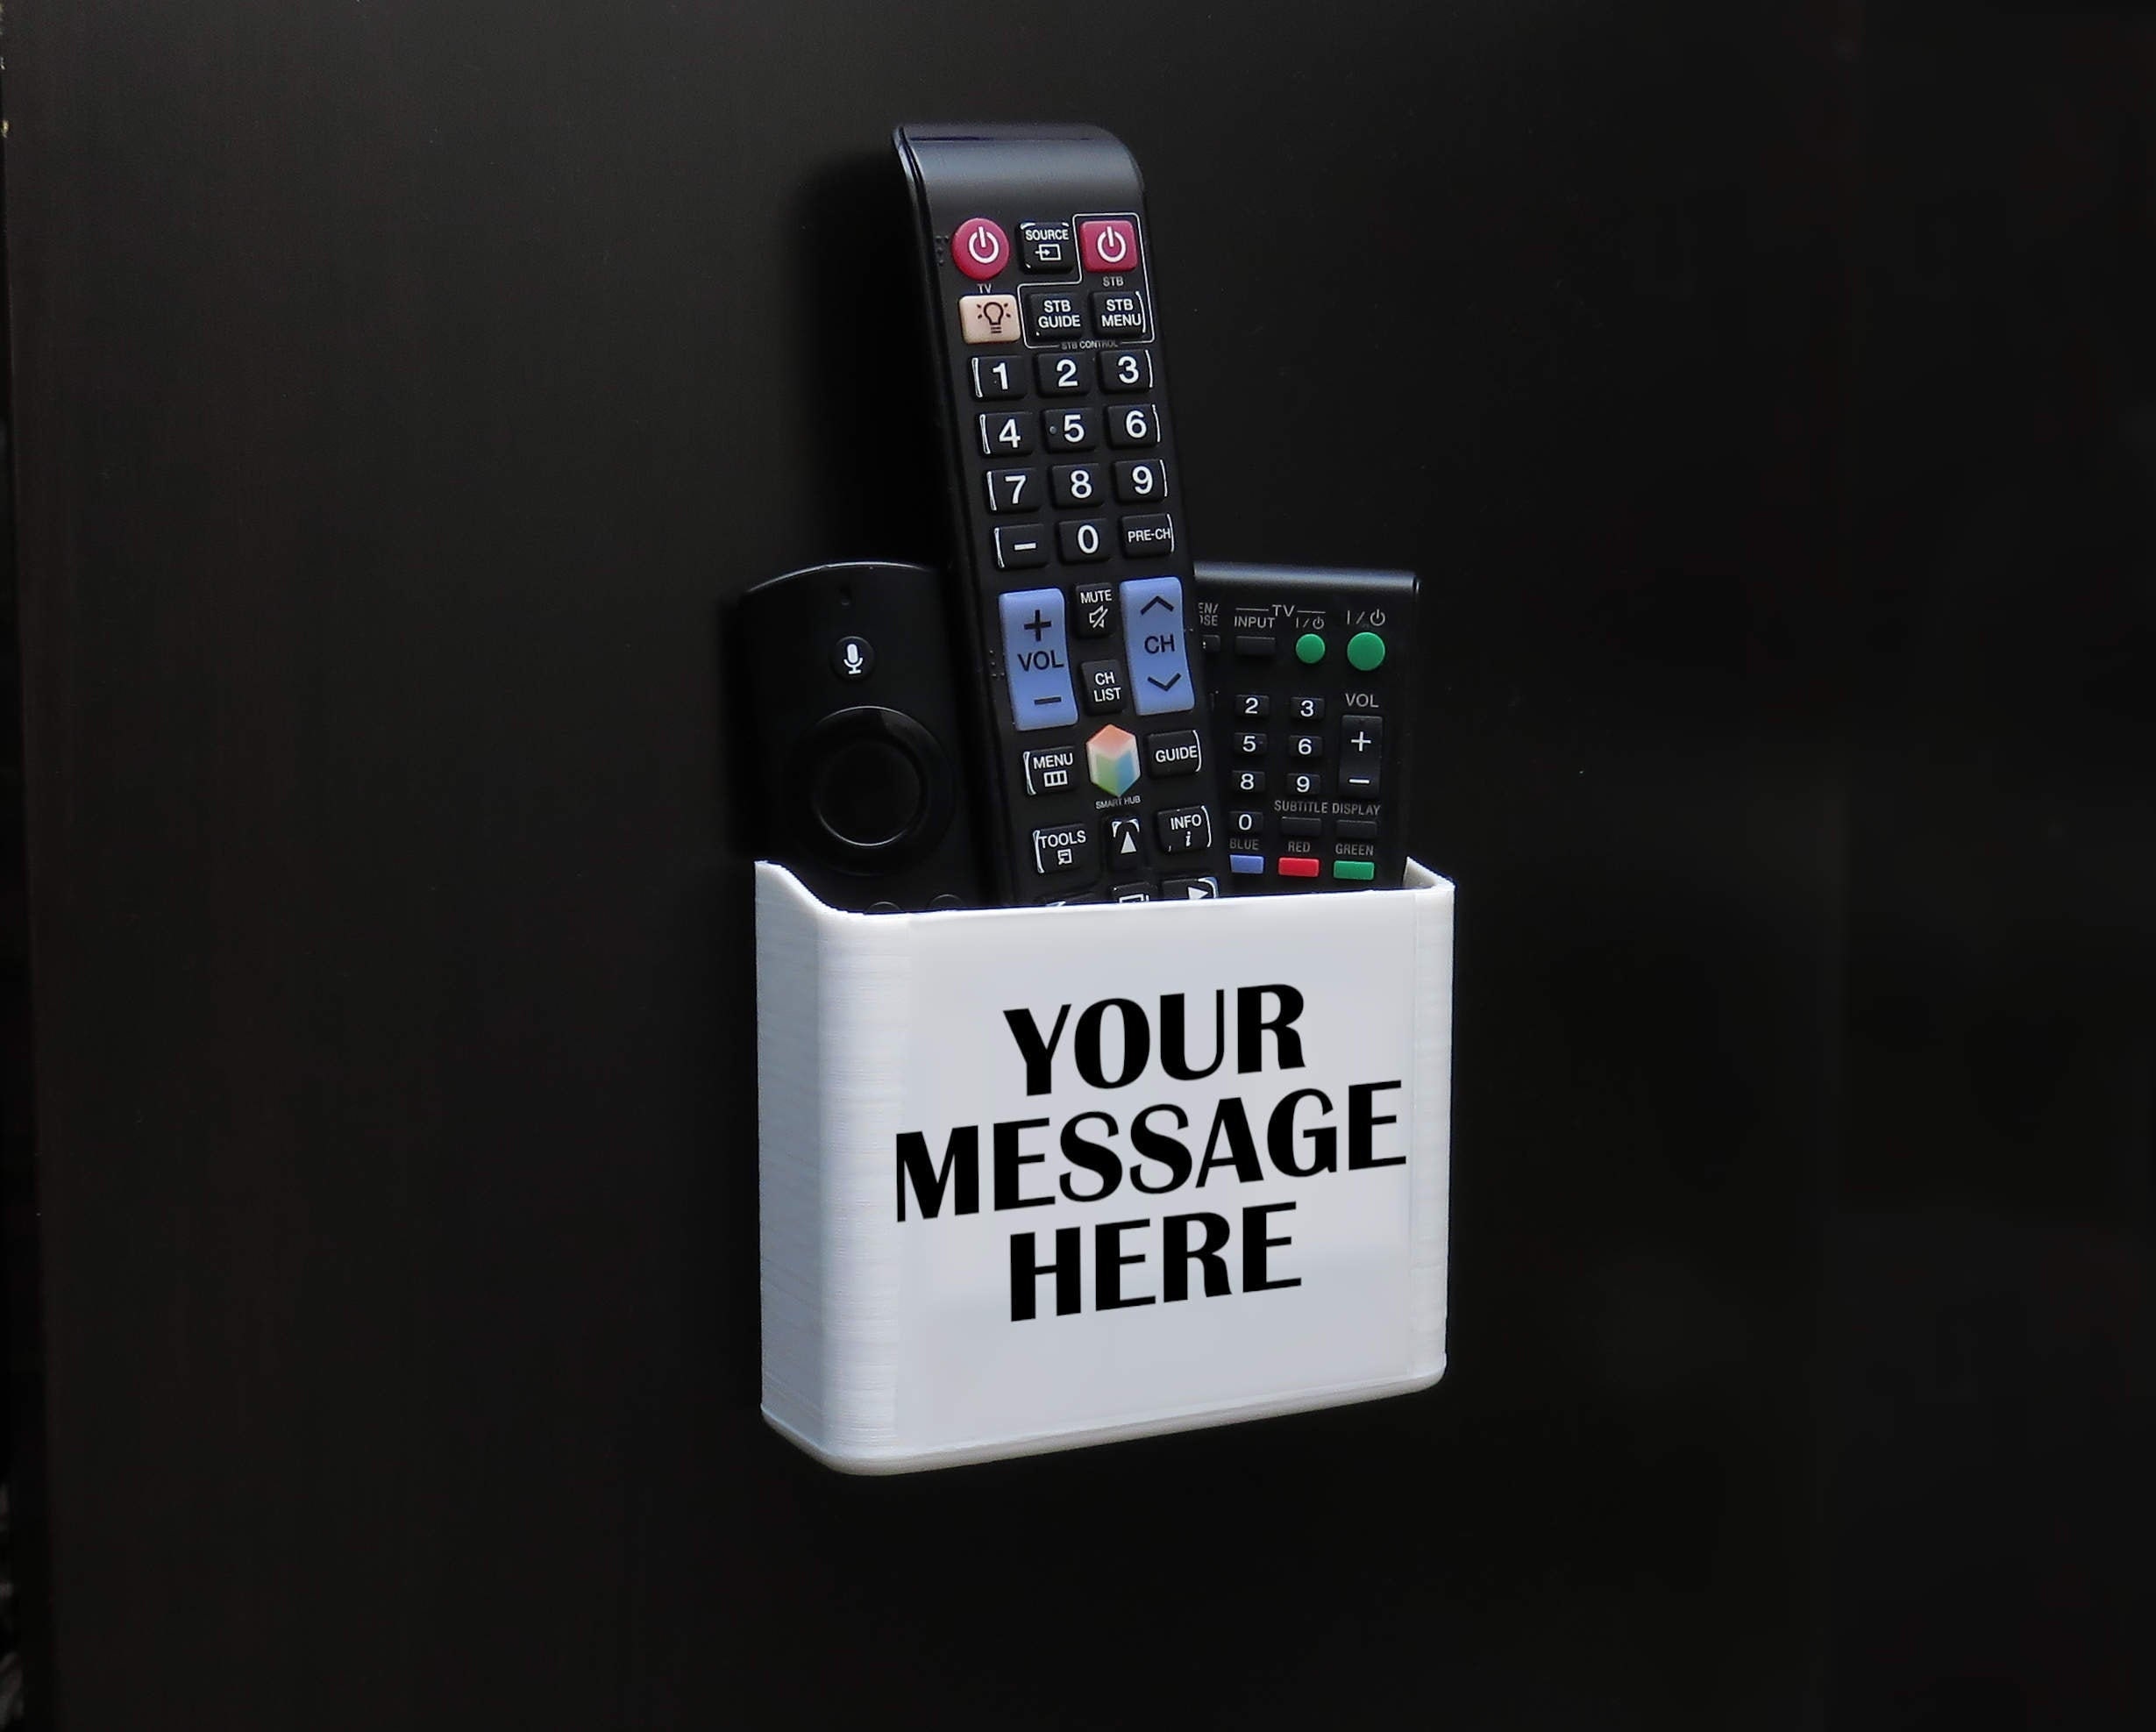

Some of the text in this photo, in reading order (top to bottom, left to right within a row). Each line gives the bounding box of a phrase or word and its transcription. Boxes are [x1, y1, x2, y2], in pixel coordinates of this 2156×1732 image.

[1024, 227, 1070, 242] SOURCE
[978, 284, 992, 293] TV
[1102, 276, 1123, 286] STB
[1042, 299, 1072, 314] STB
[1106, 299, 1133, 311] STB
[1038, 315, 1080, 327] GUIDE
[1100, 313, 1142, 328] MENU
[993, 362, 1009, 389] 1
[1057, 360, 1078, 387] 2
[1118, 355, 1139, 384] 3
[1064, 414, 1085, 442] 5
[1125, 410, 1147, 438] 6
[999, 418, 1021, 448] 4
[1071, 470, 1093, 499] 8
[1132, 466, 1153, 494] 9
[1005, 475, 1027, 504] 7
[1078, 525, 1099, 553] 0
[1128, 528, 1171, 543] PRE-CH
[1080, 589, 1112, 603] MUTE
[1272, 605, 1295, 617] TV
[1235, 617, 1275, 628] INPUT
[1145, 635, 1175, 653] CH
[1017, 652, 1064, 672] VOL
[1096, 673, 1114, 685] CH
[1094, 688, 1121, 702] LIST
[1346, 694, 1378, 707] VOL
[1245, 698, 1258, 714] 2
[1300, 701, 1313, 716] 3
[1243, 736, 1256, 752] 5
[1299, 738, 1311, 754] 6
[1034, 752, 1072, 768] MENU
[1156, 745, 1197, 762] GUIDE
[1241, 773, 1254, 789] 8
[1297, 776, 1309, 792] 9
[1096, 795, 1140, 809] SMART HUB
[1275, 800, 1327, 813] SUBTITLE
[1333, 803, 1380, 815] DISPLAY
[1171, 815, 1201, 830] INFO
[1239, 815, 1251, 830] 0
[1041, 830, 1085, 848] TOOLS
[1230, 839, 1258, 850] BLUE
[1287, 841, 1310, 852] RED
[1335, 845, 1373, 856] GREEN
[1004, 984, 1305, 1096] YOUR
[896, 1080, 1406, 1222] MESSAGE
[1010, 1201, 1301, 1322] HERE
